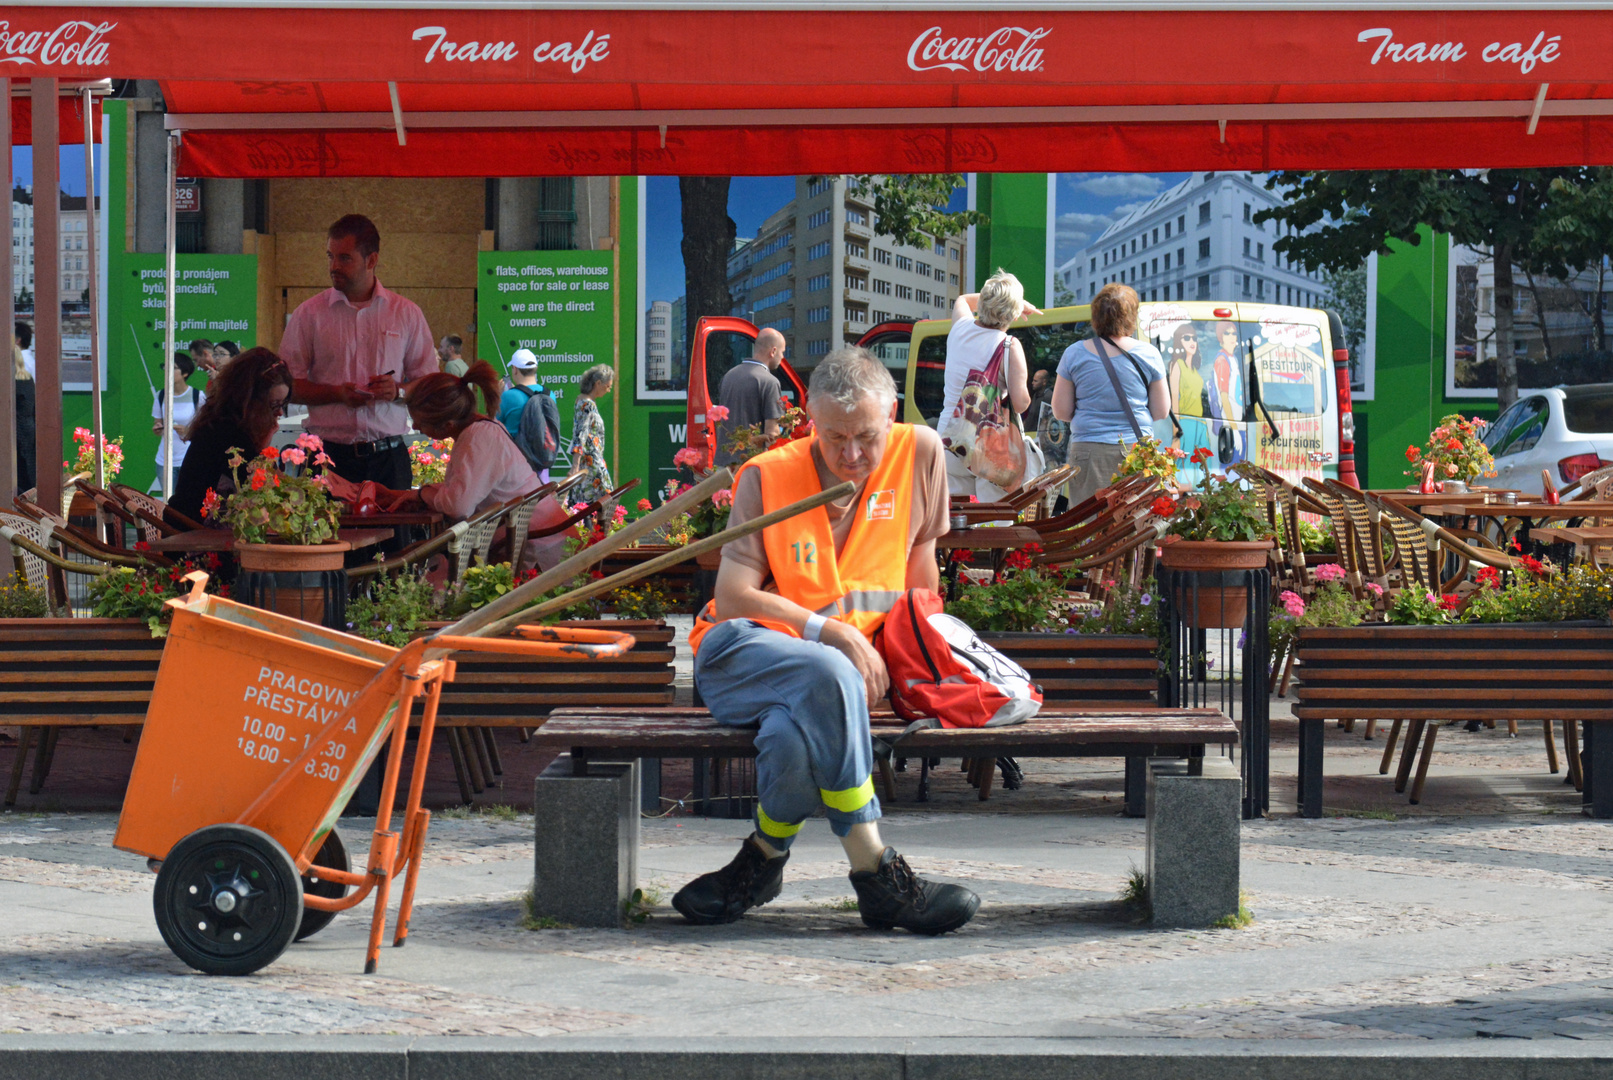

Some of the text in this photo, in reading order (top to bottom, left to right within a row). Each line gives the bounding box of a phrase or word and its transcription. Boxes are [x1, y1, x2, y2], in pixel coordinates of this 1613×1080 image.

[412, 26, 610, 73] Tram café
[907, 26, 1053, 72] Coca-Cola
[1357, 28, 1561, 74] Tram café
[141, 268, 167, 280] prode
[183, 268, 230, 281] pronájem
[496, 265, 609, 278] flats, offices, warehouse
[175, 283, 218, 296] anceláří,
[497, 280, 610, 293] space for sale or lease
[142, 298, 167, 308] skla
[511, 301, 595, 312] we are the direct
[154, 319, 179, 331] jse
[209, 319, 249, 332] majitelé
[509, 318, 547, 327] owners
[519, 339, 558, 350] you pay
[536, 352, 594, 363] commission
[1262, 360, 1286, 370] BEST
[541, 375, 568, 385] years
[1262, 419, 1319, 436] cy tours
[1261, 436, 1321, 449] excursions
[1261, 448, 1282, 461] free
[1285, 451, 1307, 467] pick
[791, 541, 816, 563] 12
[242, 715, 286, 742] 10.00
[304, 733, 347, 760] 1.30
[237, 737, 279, 764] 18.00
[303, 758, 340, 782] 8.30
